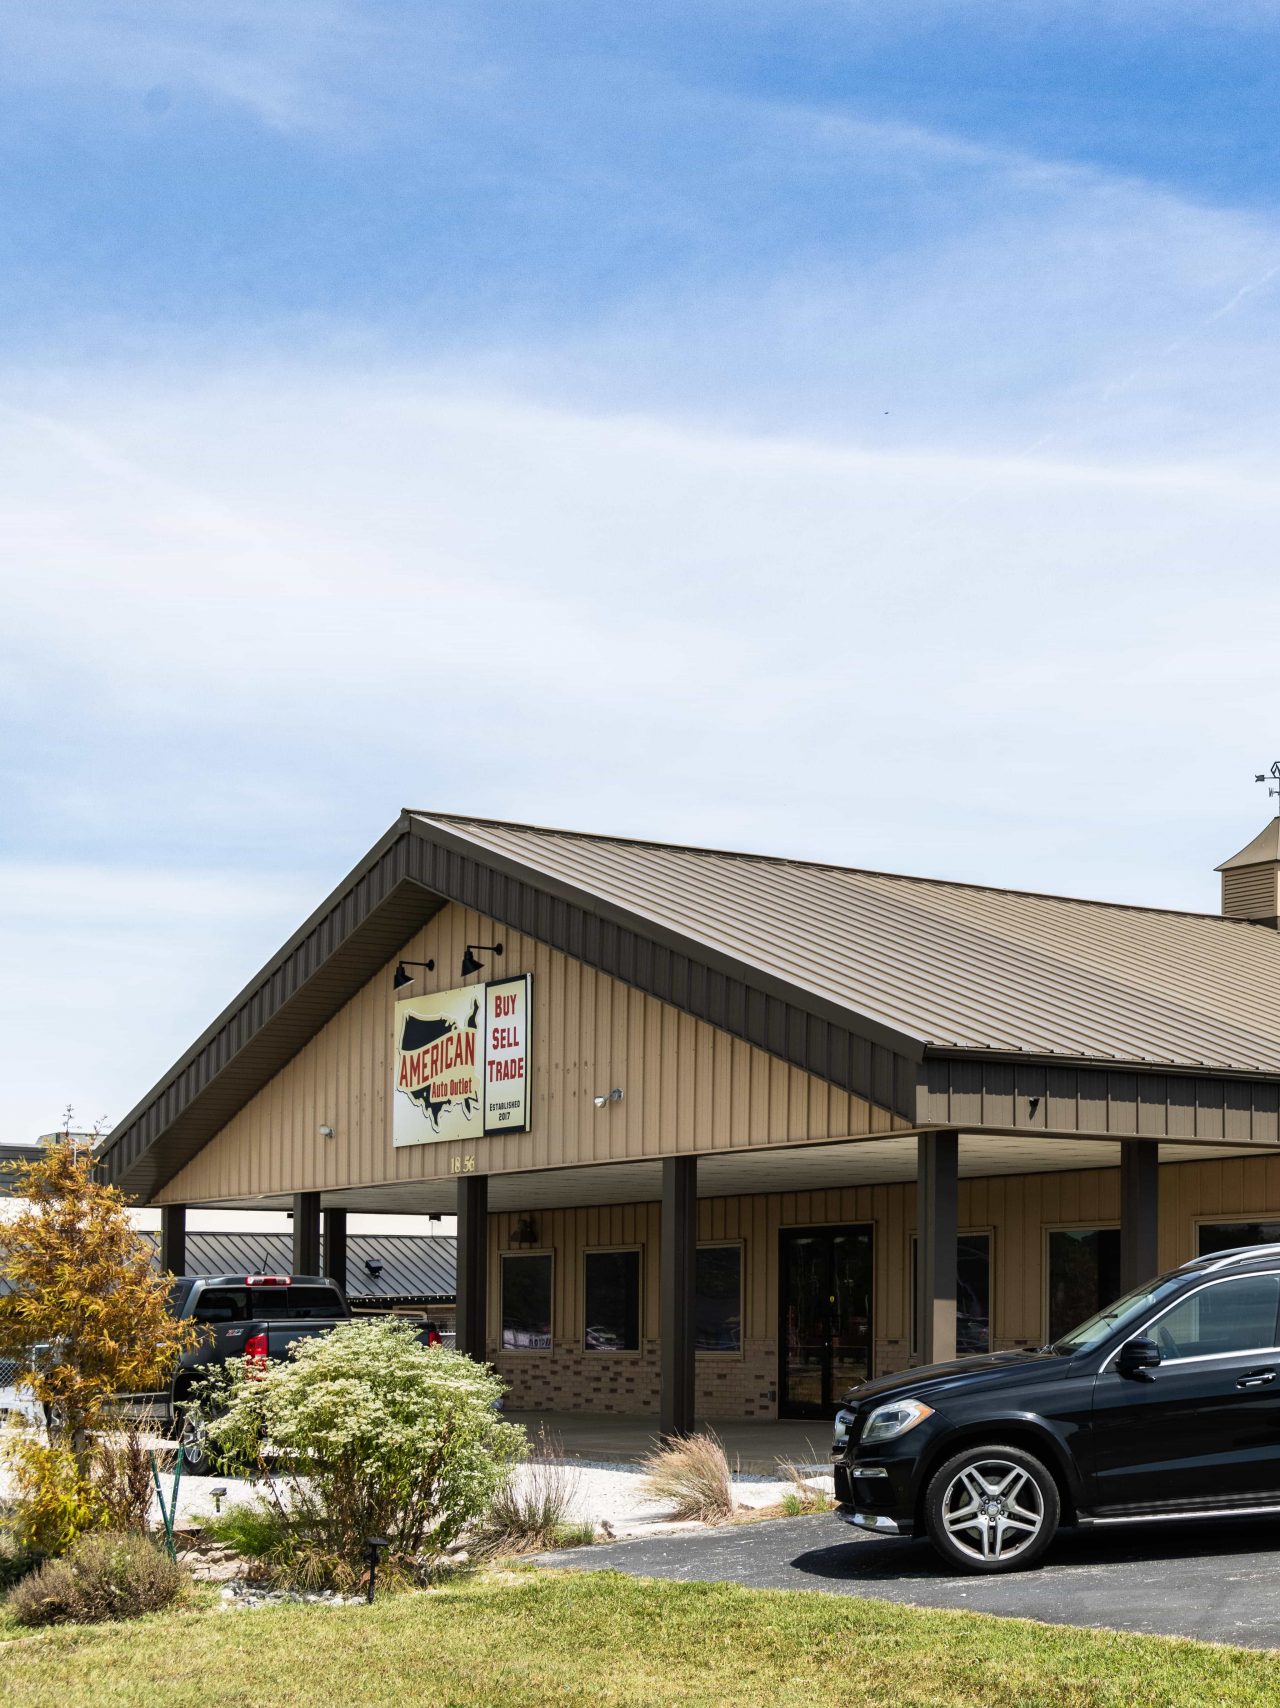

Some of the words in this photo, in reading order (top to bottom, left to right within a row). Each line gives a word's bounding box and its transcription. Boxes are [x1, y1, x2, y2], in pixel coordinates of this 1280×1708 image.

[495, 994, 517, 1018] BUY
[492, 1026, 519, 1050] SELL
[399, 1031, 475, 1088] AMERICAN
[488, 1057, 524, 1083] TRADE
[431, 1081, 448, 1099] Auto
[449, 1076, 472, 1096] Outlet
[489, 1100, 521, 1112] ESTABLISHED
[498, 1112, 511, 1121] 2017
